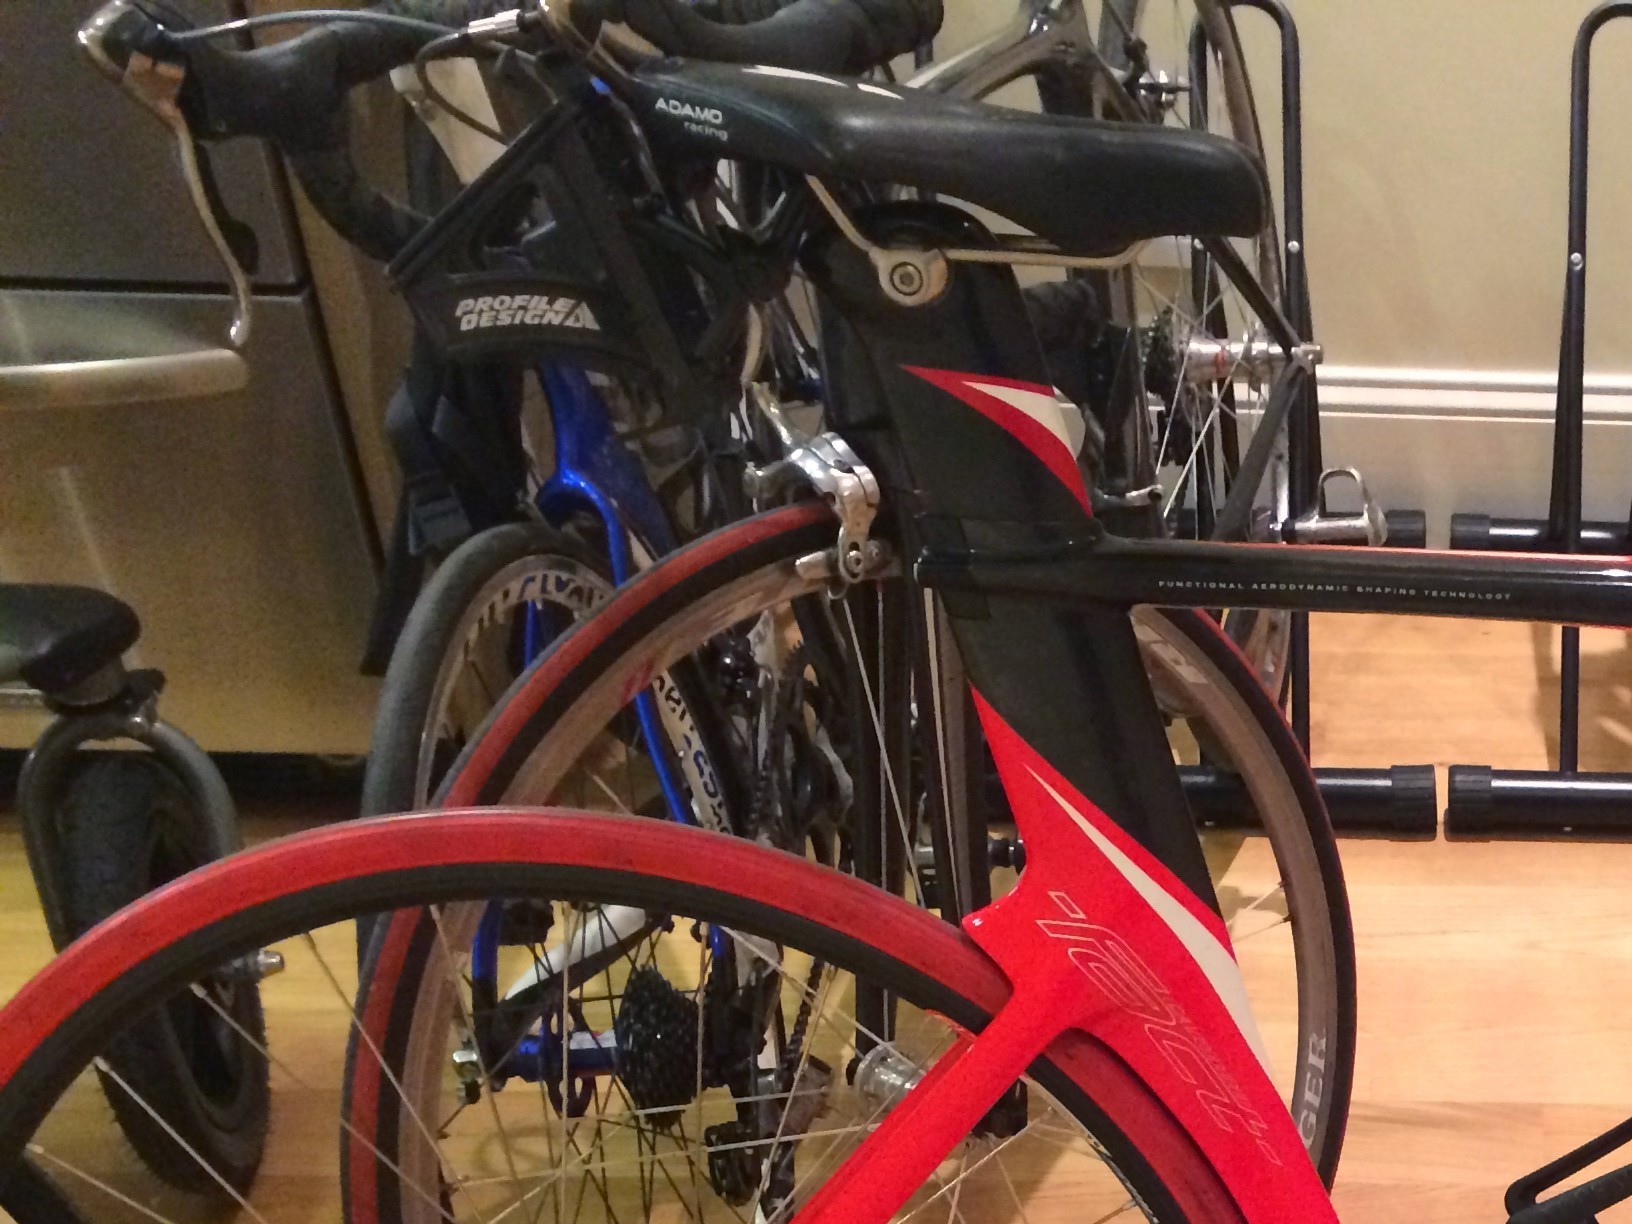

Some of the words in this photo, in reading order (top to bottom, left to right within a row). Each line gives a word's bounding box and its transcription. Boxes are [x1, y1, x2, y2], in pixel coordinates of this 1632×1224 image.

[655, 97, 722, 124] ADAMO
[683, 120, 728, 141] racing
[455, 294, 576, 317] PROFILE
[460, 308, 564, 331] DESIGN
[1158, 580, 1244, 590] FUNCTIONAL
[1251, 583, 1349, 592] AERODYNAMIC
[1356, 586, 1417, 596] SHAPING
[1423, 589, 1512, 601] TECHNOLOGY
